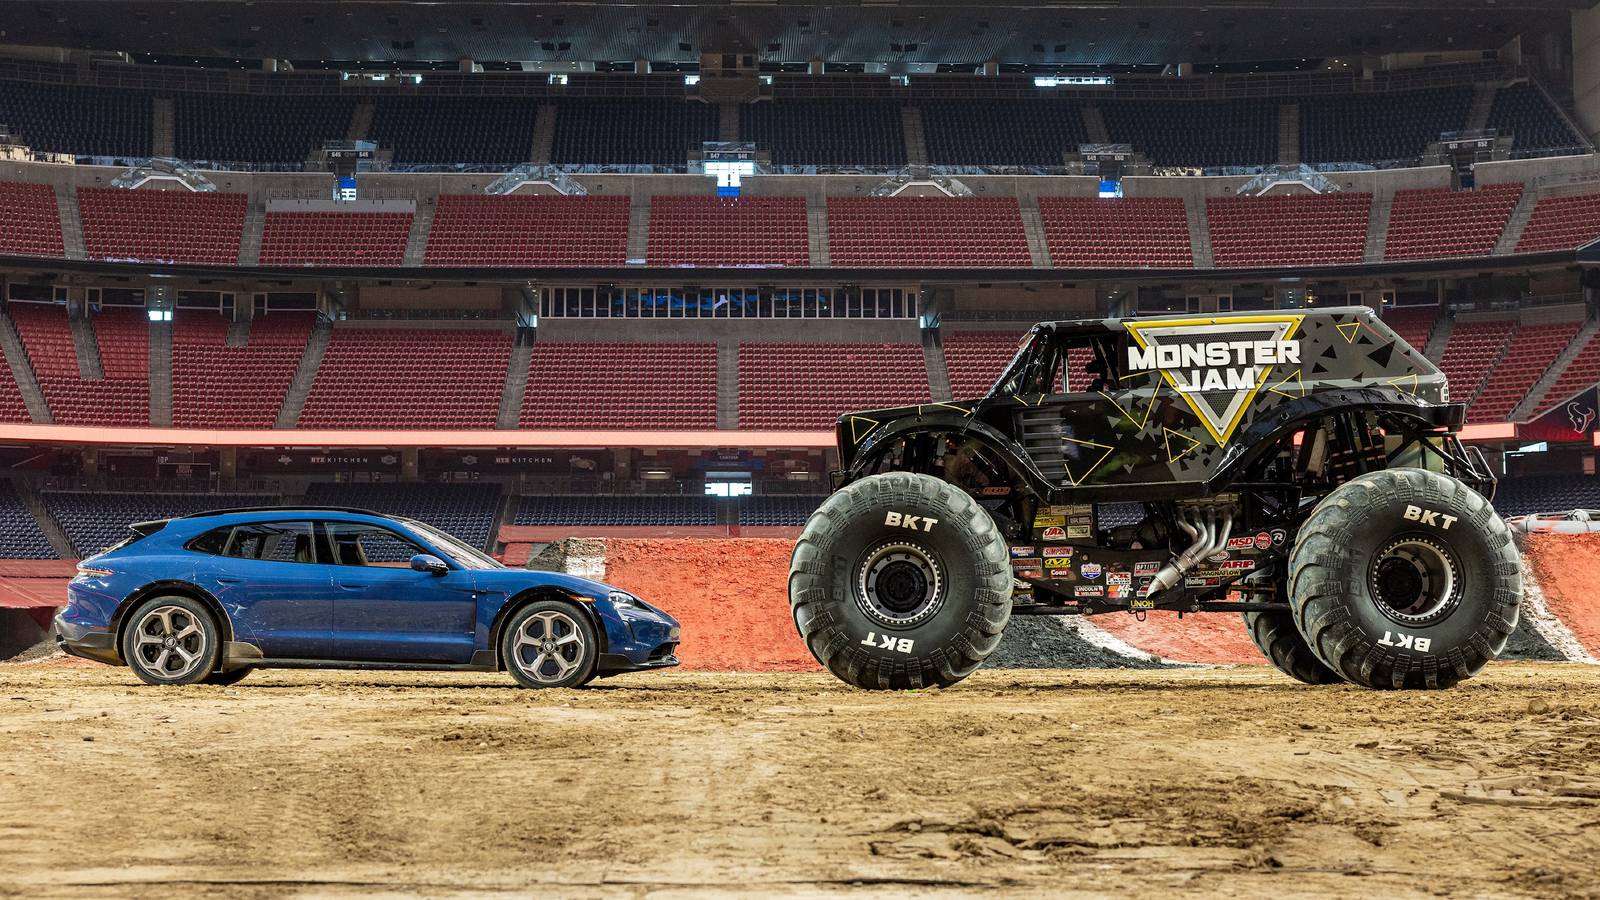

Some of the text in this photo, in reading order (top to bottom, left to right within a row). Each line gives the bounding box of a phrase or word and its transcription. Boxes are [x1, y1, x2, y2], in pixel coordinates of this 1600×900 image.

[1127, 340, 1302, 371] MONSTER
[1178, 367, 1256, 393] JAM
[884, 511, 939, 533] BKT
[1403, 504, 1458, 530] BKT
[1044, 527, 1064, 536] JAZ
[1228, 537, 1253, 547] MSD
[1221, 560, 1254, 568] ARP
[1186, 578, 1206, 586] Holley
[860, 631, 915, 654] BKT
[1377, 630, 1431, 653] BKT
